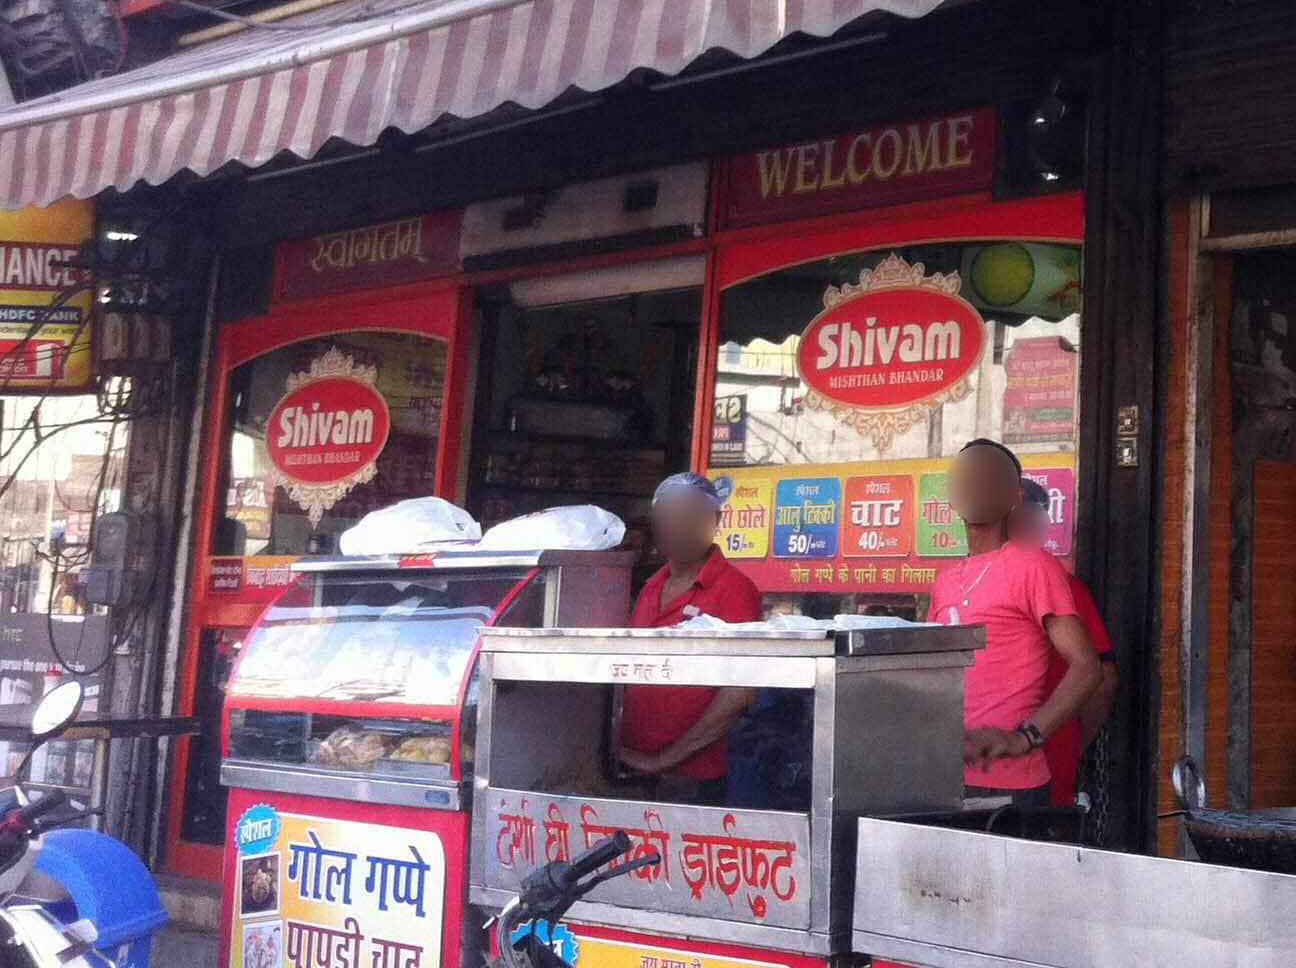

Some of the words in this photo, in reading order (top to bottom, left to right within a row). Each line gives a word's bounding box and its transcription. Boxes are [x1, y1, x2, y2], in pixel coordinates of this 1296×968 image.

[756, 115, 975, 199] WELCOME
[41, 311, 79, 321] ANK
[817, 317, 961, 370] Shivam
[829, 372, 886, 389] MISHTHAN
[889, 368, 944, 384] BHANDAR
[278, 402, 374, 448] Shivam
[851, 500, 904, 527] चाट
[901, 563, 936, 583] गिलास
[288, 832, 358, 905] गोल
[365, 845, 431, 917] गप्पे
